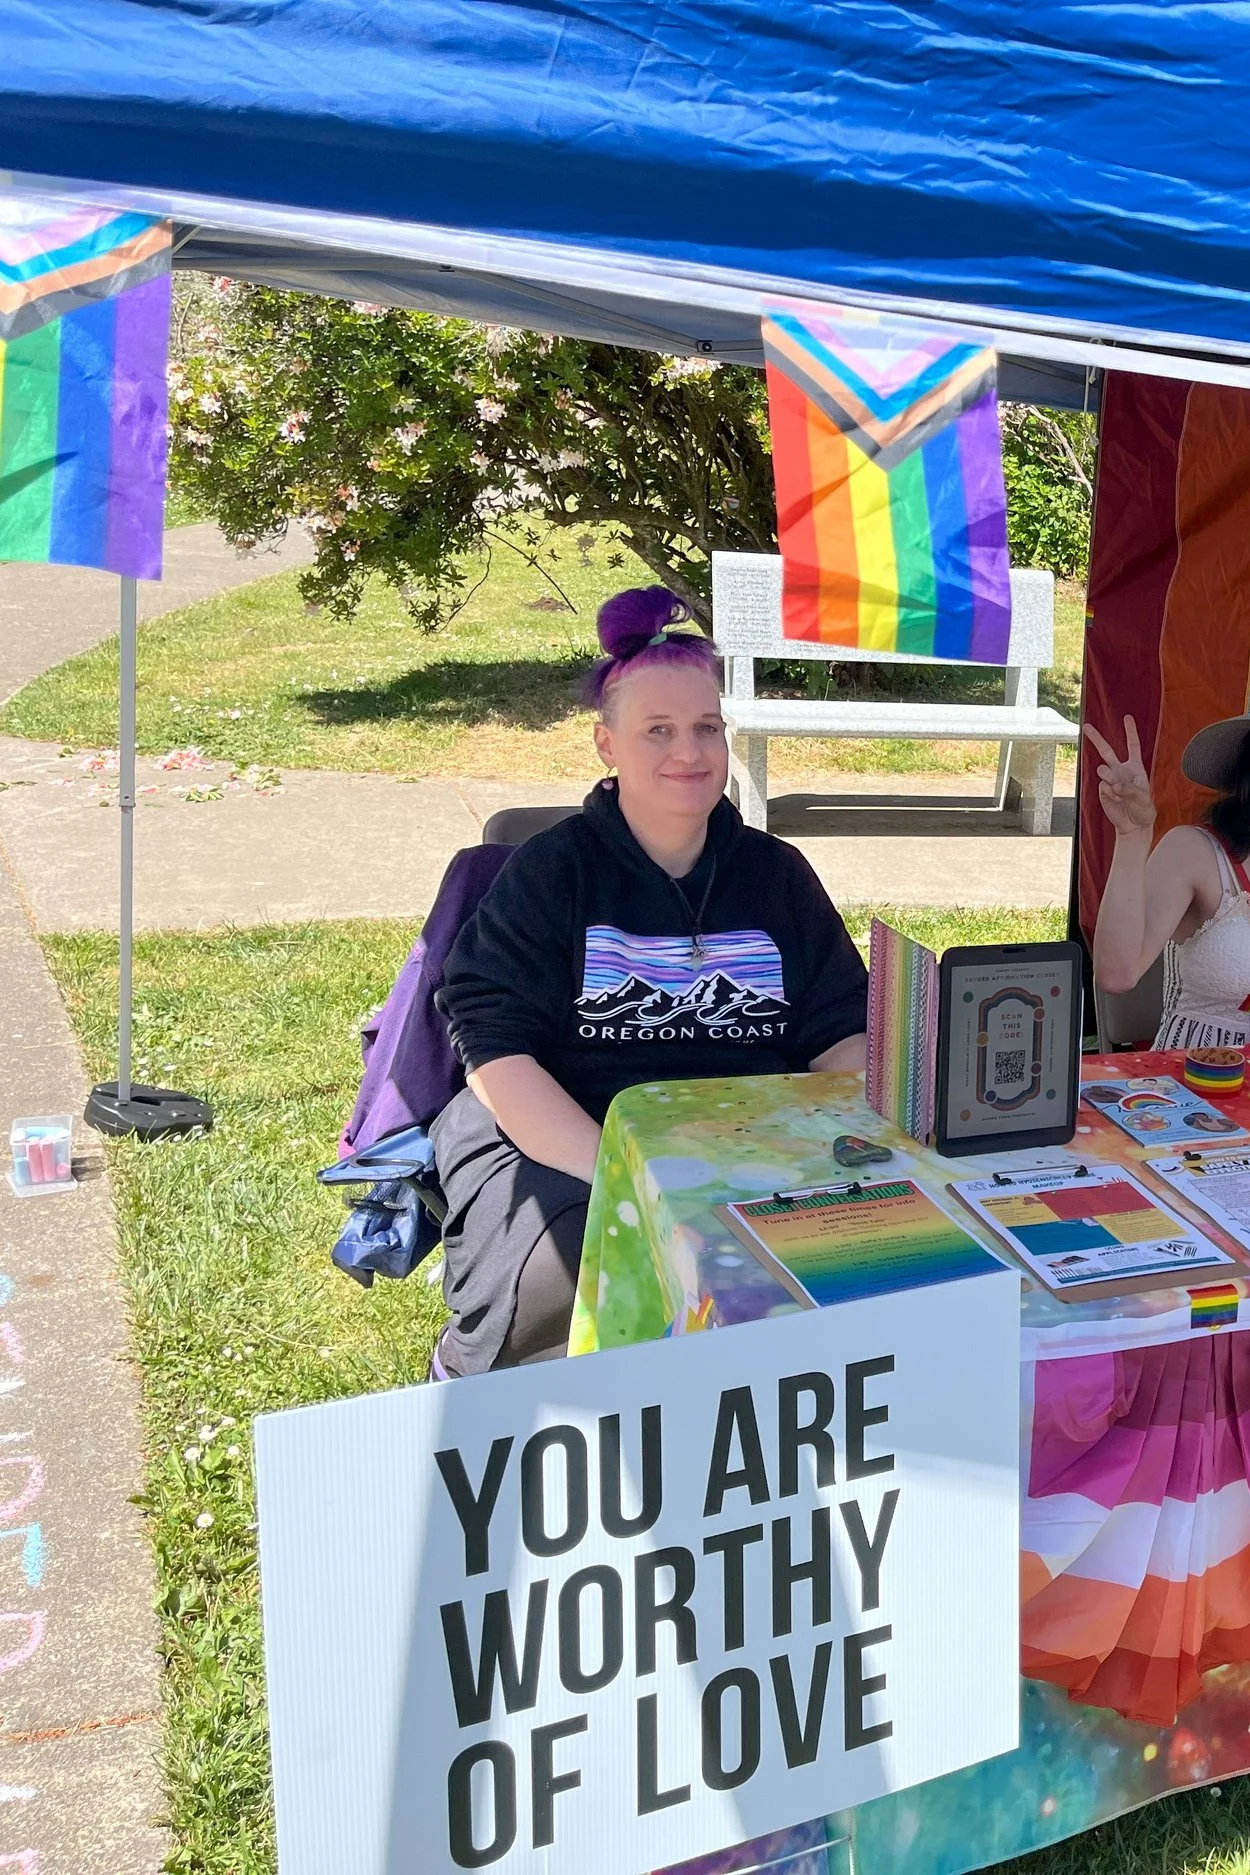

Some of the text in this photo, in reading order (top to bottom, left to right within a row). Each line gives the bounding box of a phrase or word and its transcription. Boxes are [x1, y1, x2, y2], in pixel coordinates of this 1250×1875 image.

[578, 1022, 788, 1040] OREGON COAST
[1200, 1159, 1245, 1170] SAFELY
[799, 1184, 915, 1211] CONVERSATIONS
[1032, 1181, 1064, 1189] MAKEUP
[762, 1217, 790, 1225] Tune
[816, 1208, 846, 1218] these
[848, 1204, 878, 1213] times
[895, 1199, 916, 1207] info
[822, 1212, 873, 1225] sessions!
[435, 1354, 896, 1577] YOU ARE
[439, 1488, 900, 1729] WORTHY
[447, 1624, 893, 1870] OF LOVE
